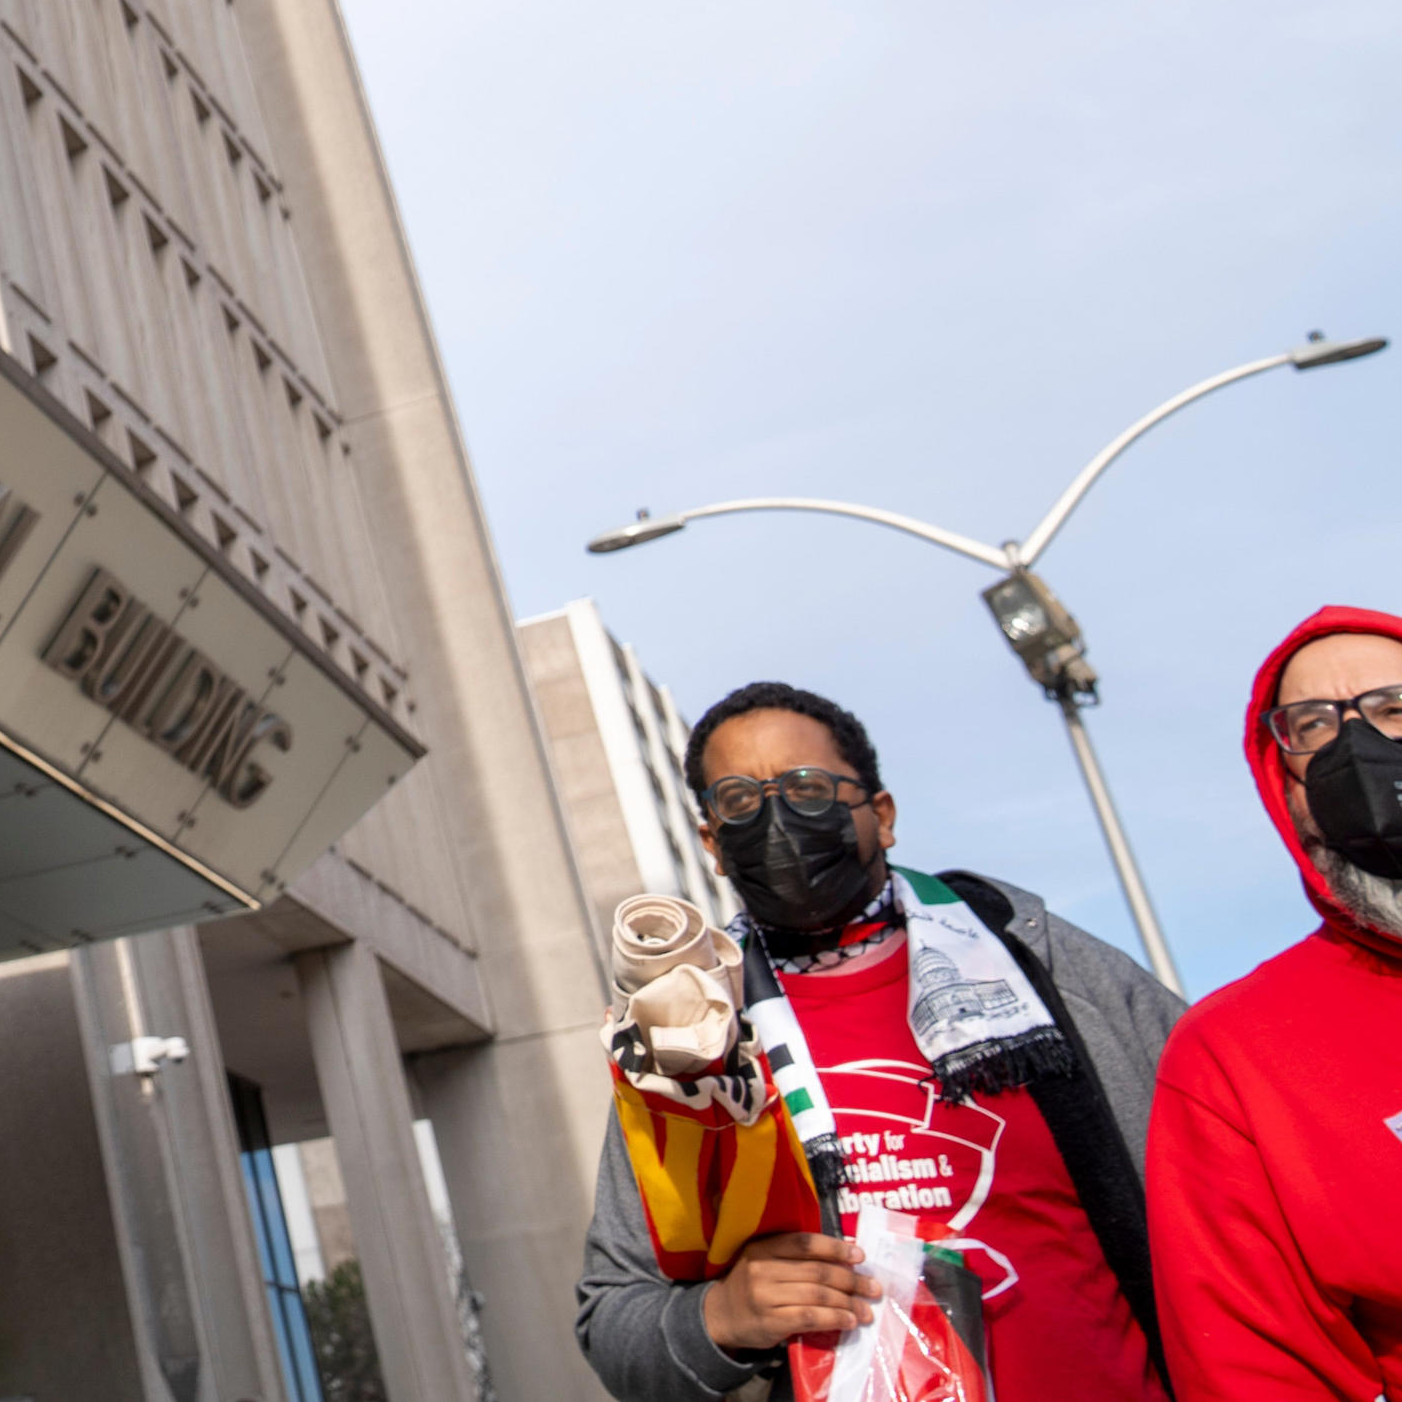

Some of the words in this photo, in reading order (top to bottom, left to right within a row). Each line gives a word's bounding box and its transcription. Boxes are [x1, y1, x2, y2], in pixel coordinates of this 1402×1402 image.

[41, 566, 290, 811] BUILDING
[884, 1130, 906, 1151] for
[938, 1154, 954, 1177] &
